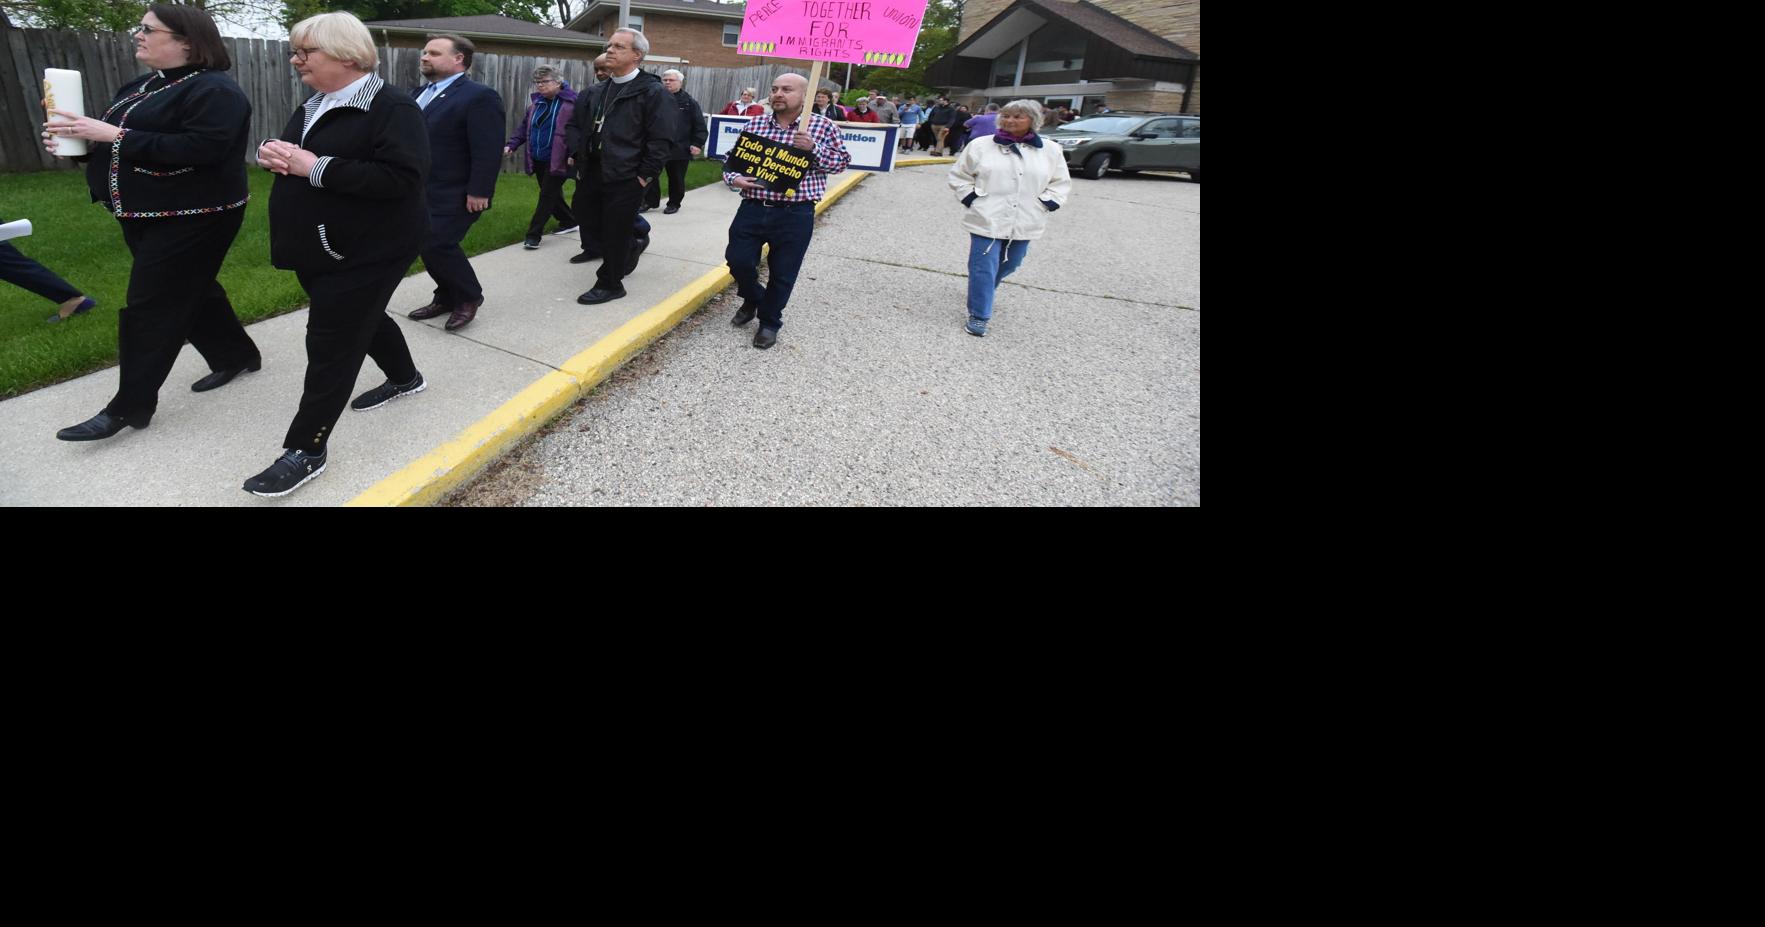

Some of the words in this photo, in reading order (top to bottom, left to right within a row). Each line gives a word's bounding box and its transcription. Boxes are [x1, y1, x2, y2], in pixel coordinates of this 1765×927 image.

[803, 0, 871, 20] TOGETHER
[809, 21, 848, 38] FOR
[780, 35, 864, 50] IMMIGRANTS
[800, 47, 850, 58] RIGHTS
[740, 136, 763, 152] Todo
[764, 146, 777, 156] el
[776, 149, 809, 168] Mundo
[735, 147, 761, 164] Tiene
[762, 157, 802, 179] Derecho
[746, 166, 754, 174] a
[756, 167, 778, 182] Vivir
